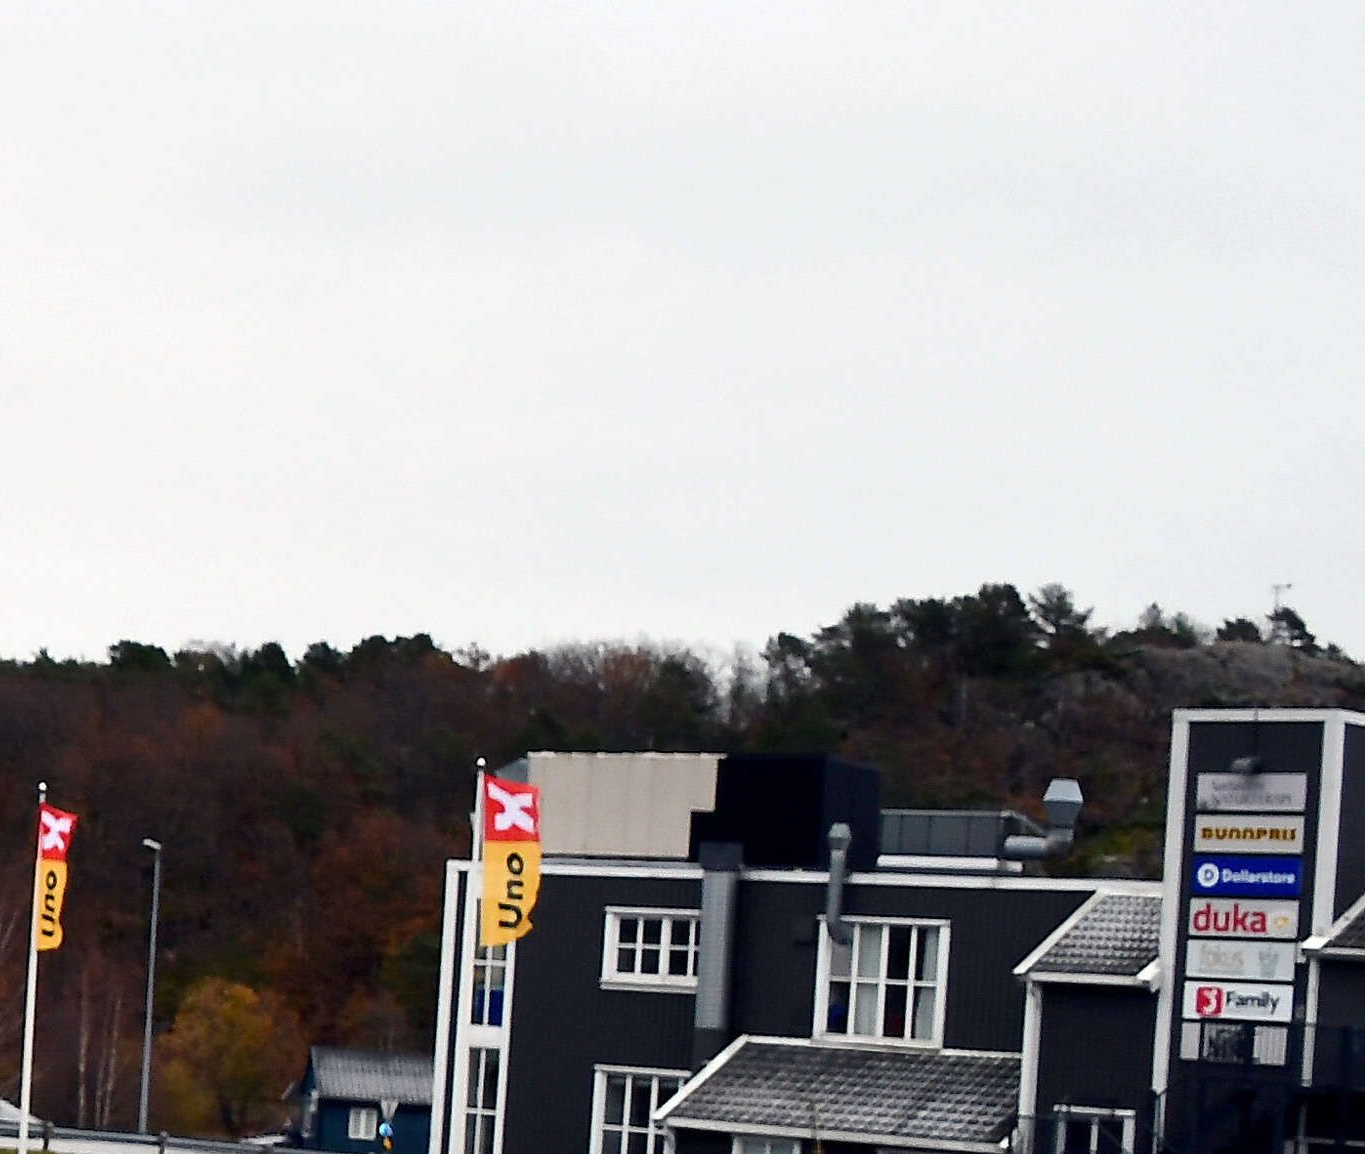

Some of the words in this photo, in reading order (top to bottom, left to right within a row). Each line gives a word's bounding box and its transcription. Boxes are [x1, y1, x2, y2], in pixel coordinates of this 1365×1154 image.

[41, 870, 57, 937] Uno
[498, 852, 524, 929] Uno
[1193, 903, 1267, 933] duka
[1226, 991, 1280, 1015] Family
